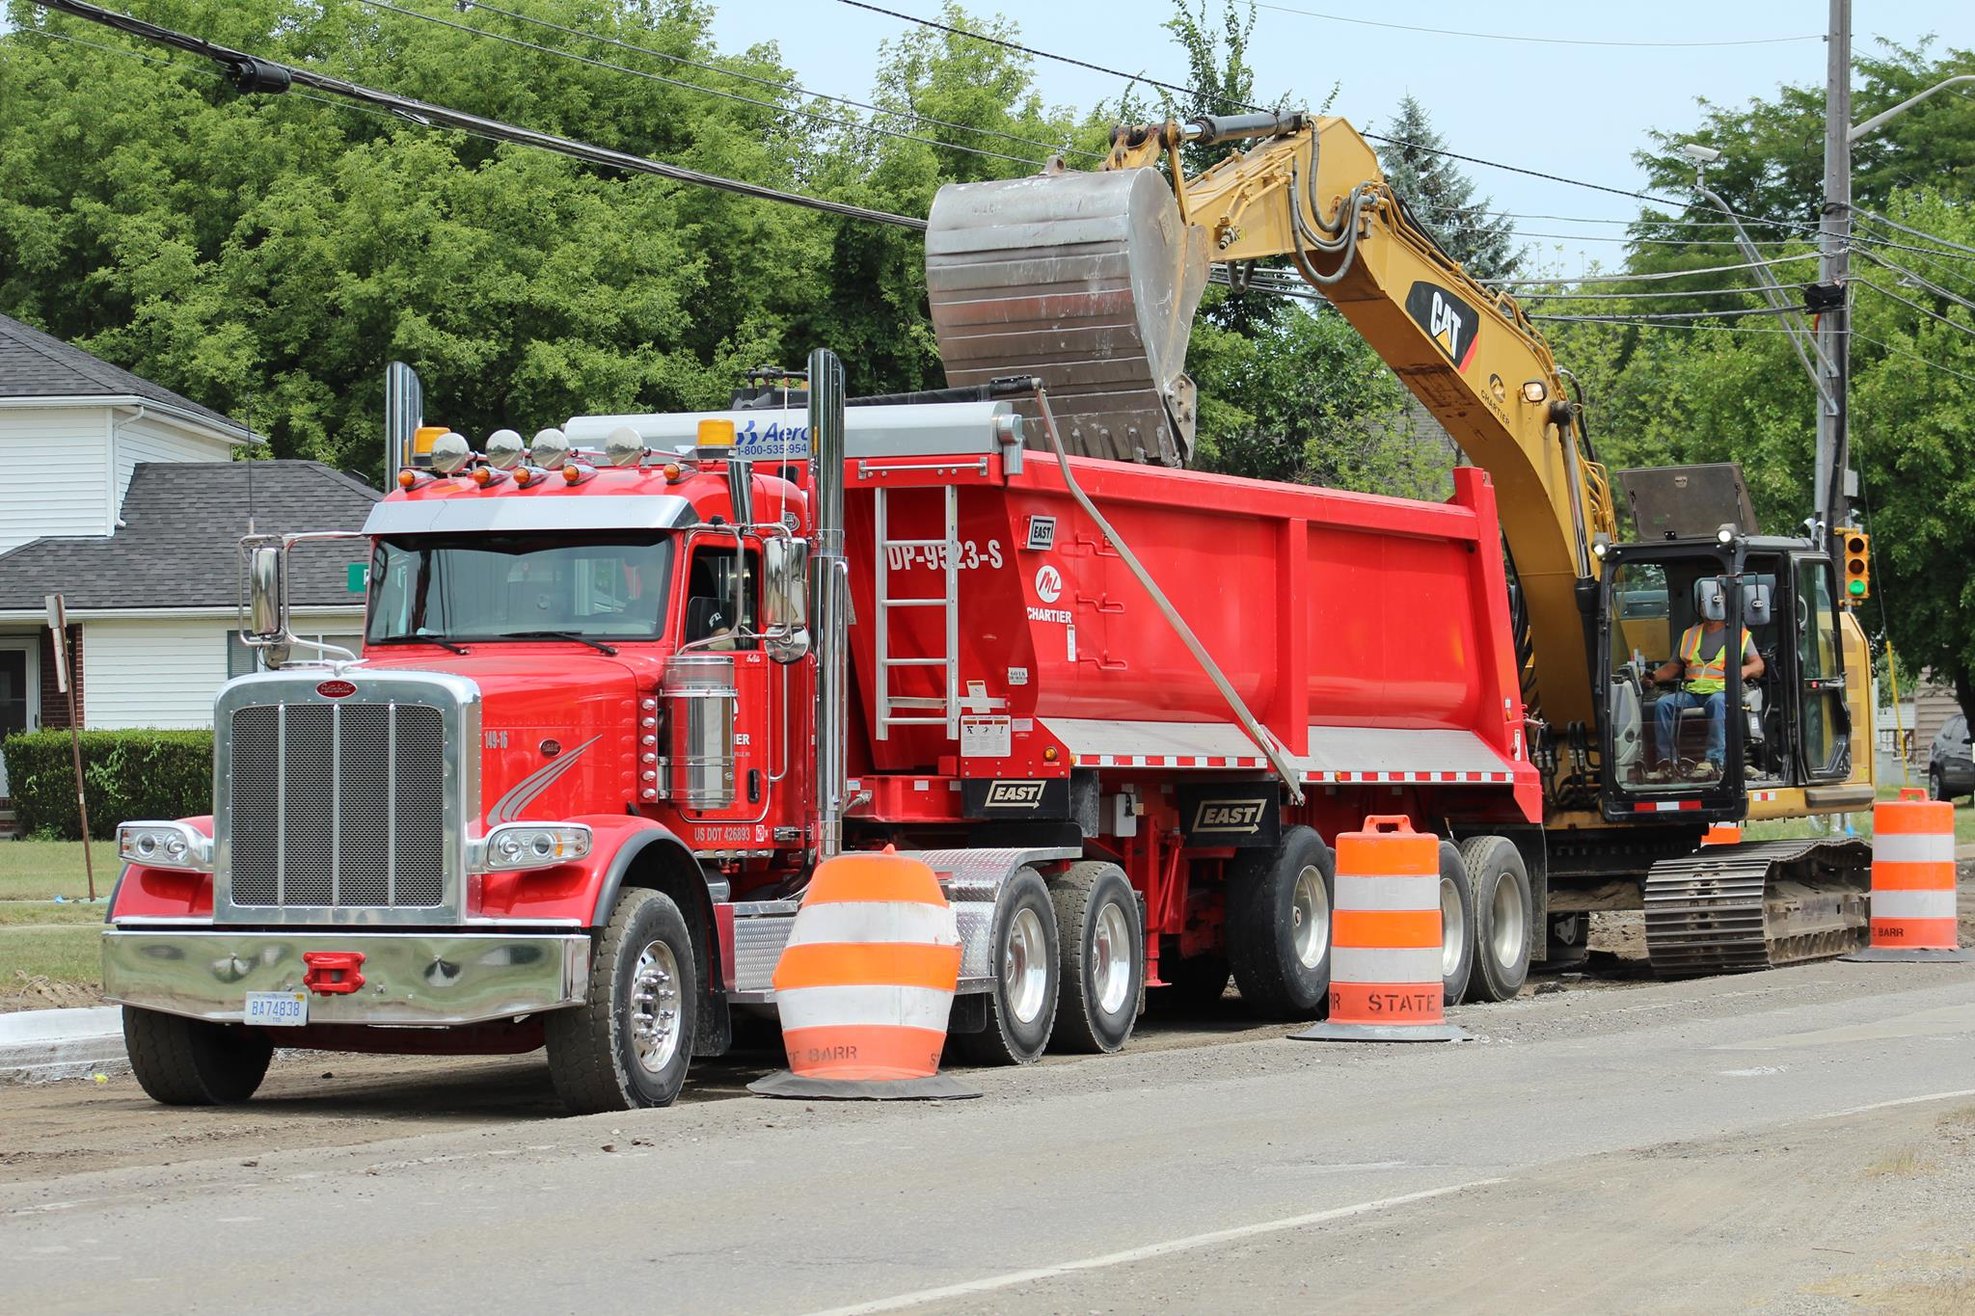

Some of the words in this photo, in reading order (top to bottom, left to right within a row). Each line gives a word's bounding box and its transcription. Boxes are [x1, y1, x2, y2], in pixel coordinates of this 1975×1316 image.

[1430, 291, 1462, 360] CAT
[737, 443, 807, 456] 1-800-535-954
[1034, 525, 1052, 539] EAST
[1026, 607, 1072, 624] CHARTIER
[994, 786, 1038, 801] EAST
[1203, 807, 1258, 824] EAST
[694, 827, 705, 841] US
[707, 827, 722, 841] DOT
[1878, 928, 1904, 937] BARR
[1368, 994, 1436, 1012] STATE
[808, 1046, 857, 1062] BARR
